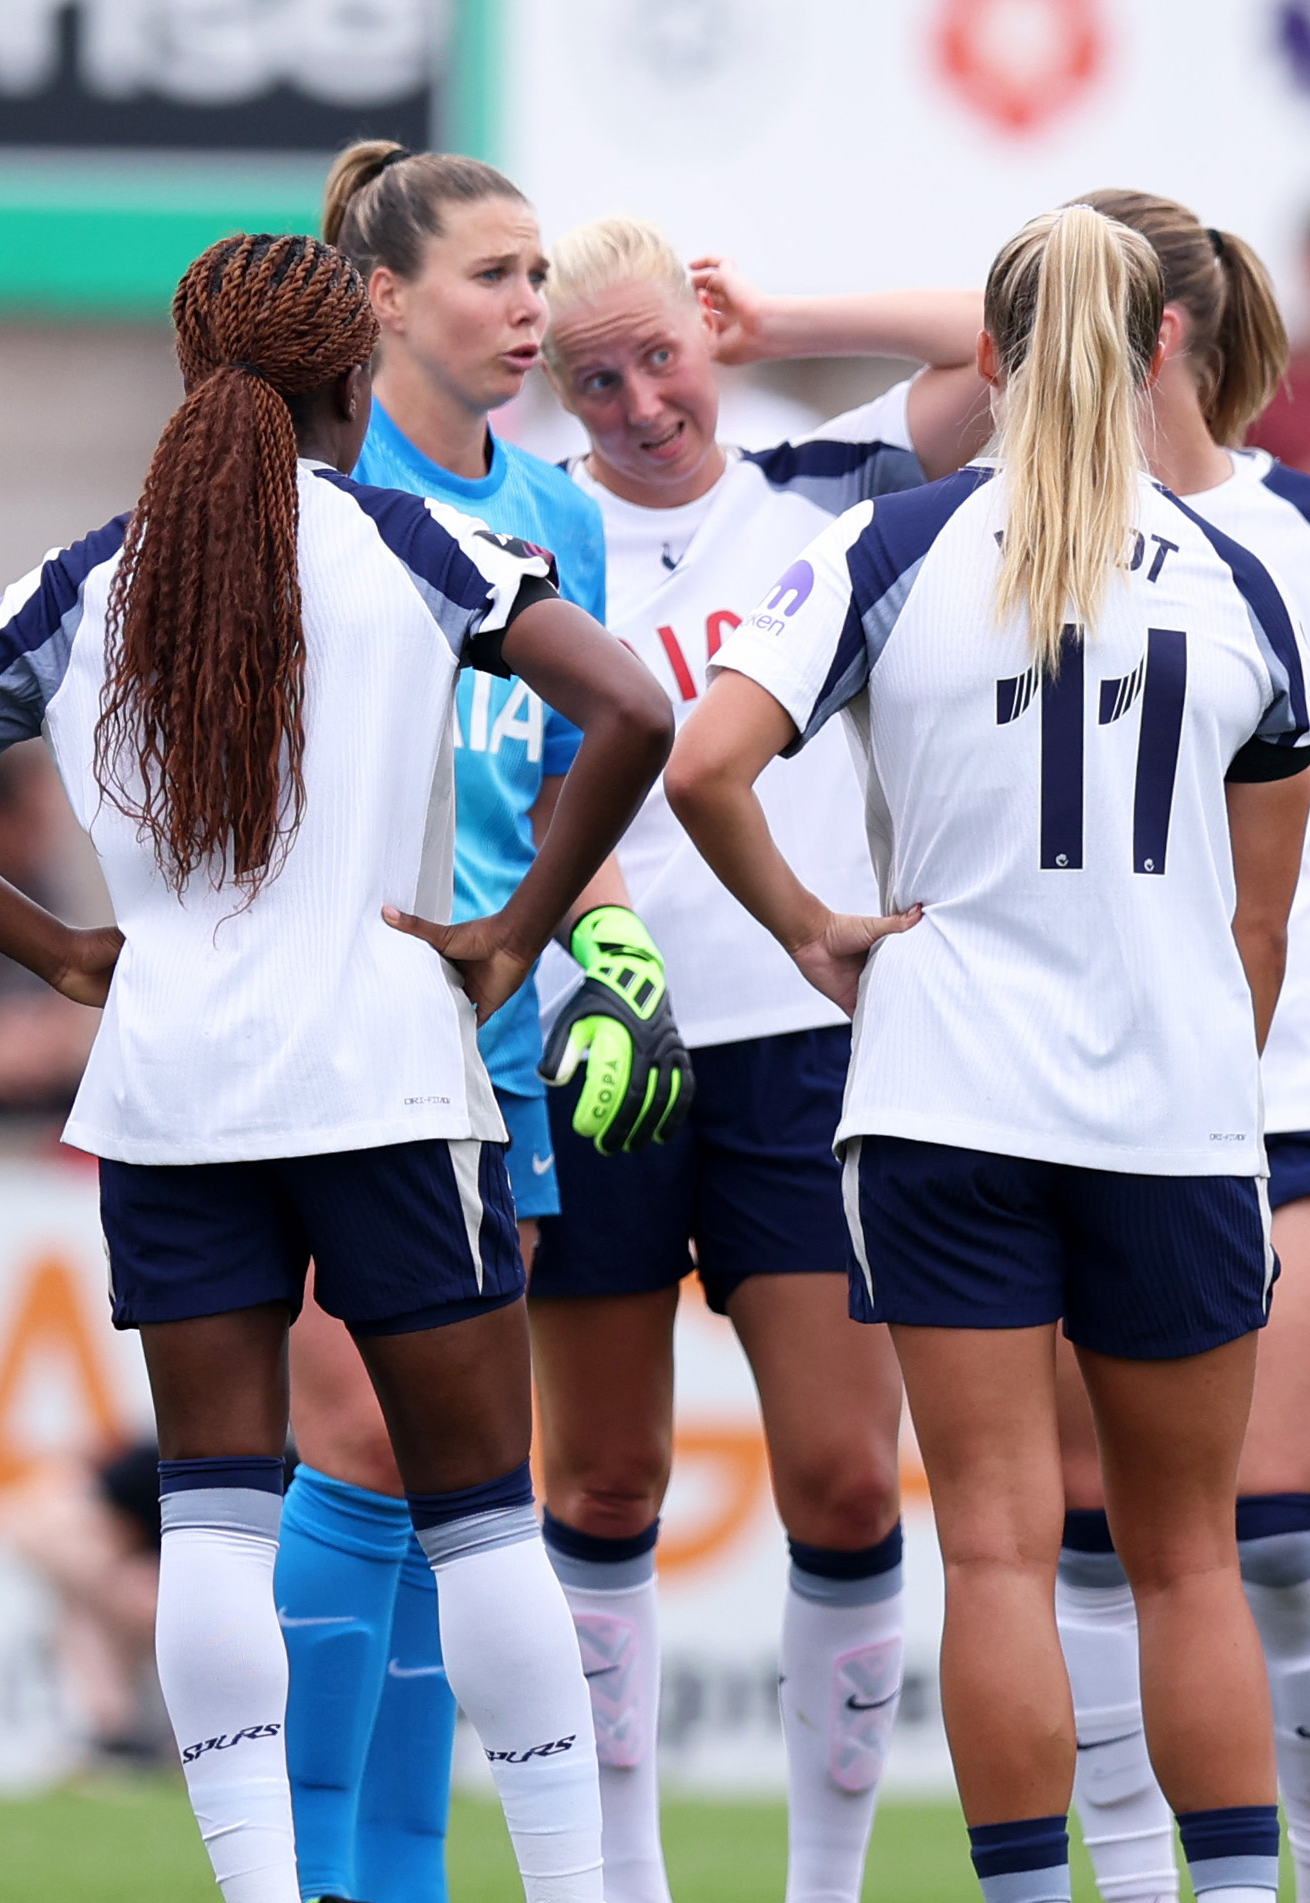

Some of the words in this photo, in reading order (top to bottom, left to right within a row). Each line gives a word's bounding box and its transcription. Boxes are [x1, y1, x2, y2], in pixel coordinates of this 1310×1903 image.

[453, 670, 544, 763] IA
[995, 622, 1187, 876] 11
[592, 1058, 620, 1119] COPA
[182, 1723, 281, 1764] SPURS
